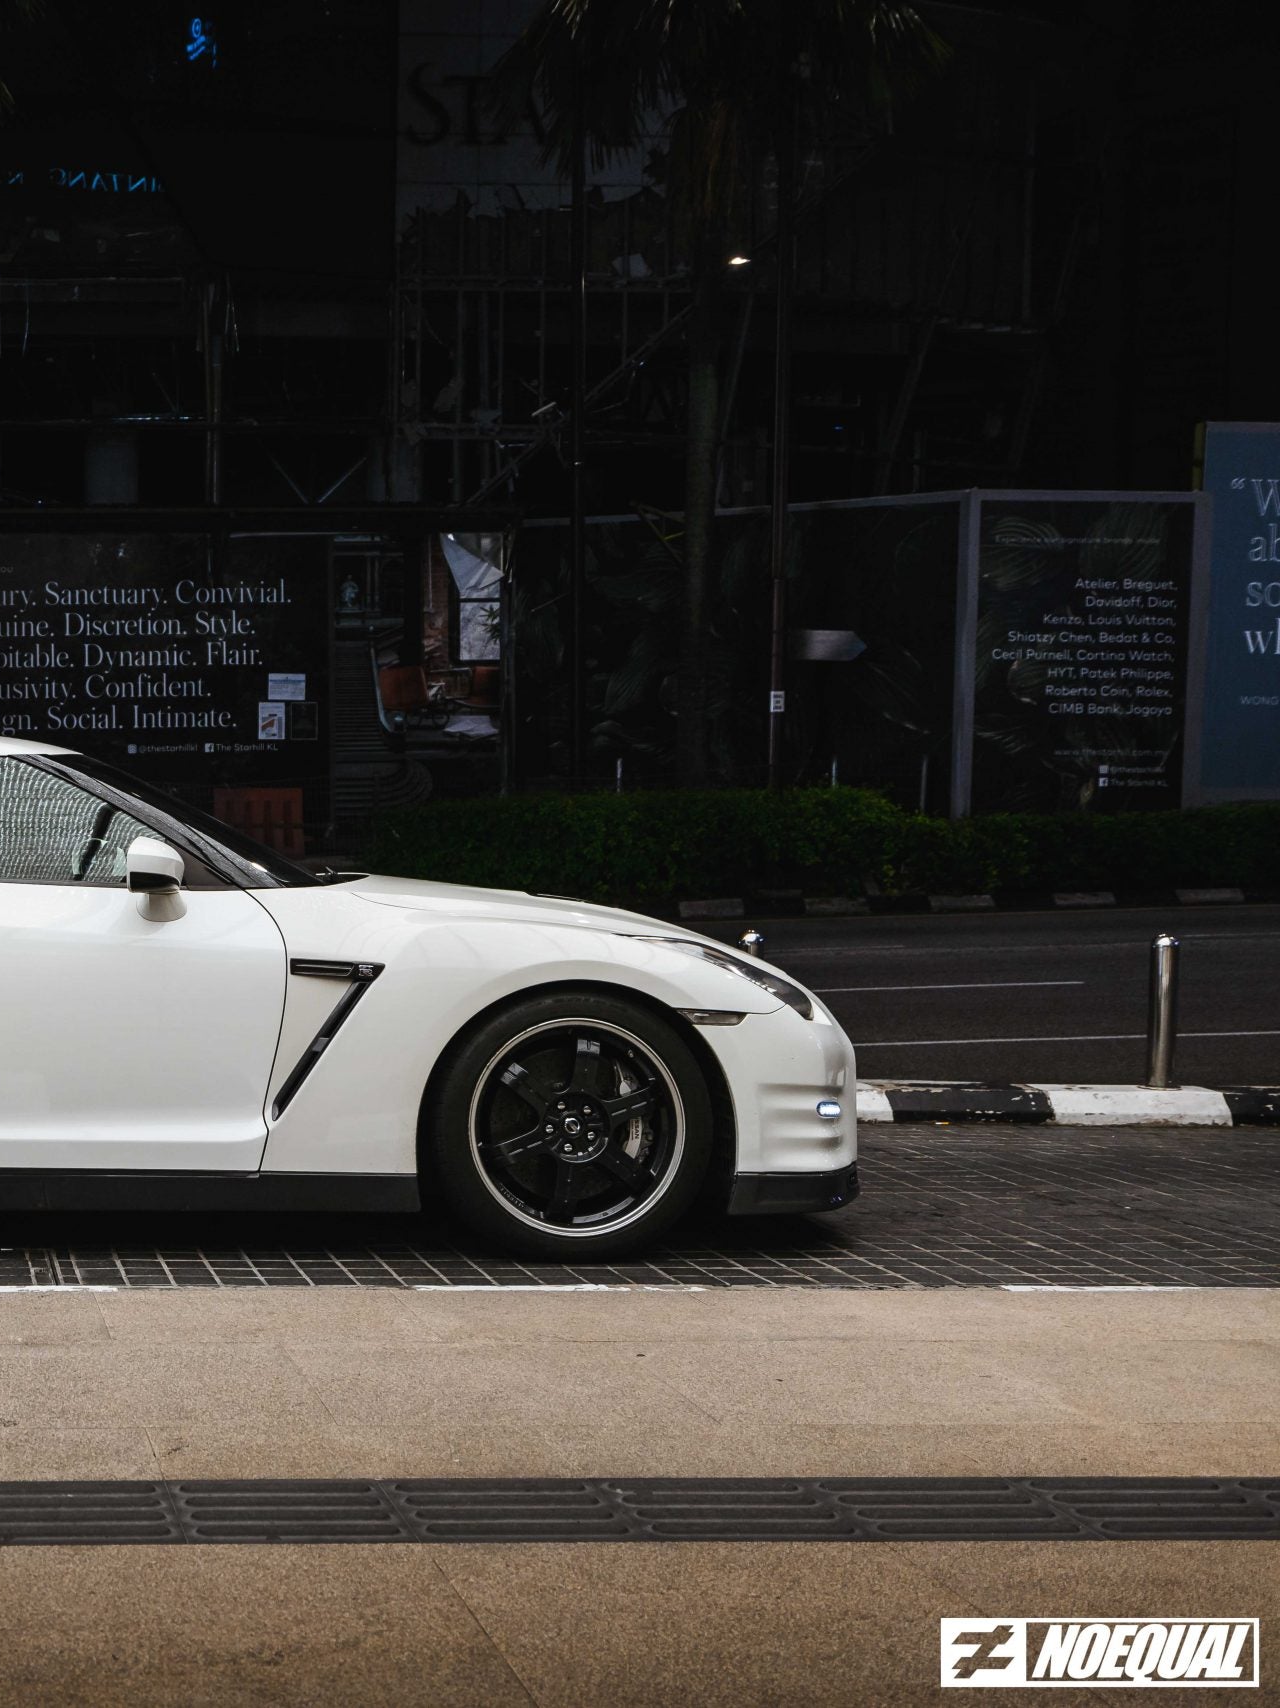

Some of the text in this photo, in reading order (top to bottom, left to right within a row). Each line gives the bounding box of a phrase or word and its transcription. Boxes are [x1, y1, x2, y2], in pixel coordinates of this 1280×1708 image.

[45, 581, 167, 611] Sanctuary.
[175, 578, 291, 605] Convivial.
[1147, 597, 1177, 609] Dior,
[65, 612, 187, 637] Discretion.
[195, 610, 256, 640] Style.
[1088, 615, 1122, 626] Louis
[1098, 632, 1138, 644] Bedat
[1141, 633, 1151, 644] &
[83, 642, 197, 674] Dynamic.
[206, 641, 263, 667] Flair.
[991, 649, 1023, 661] Cecil
[1076, 650, 1126, 662] Cortina
[1079, 668, 1118, 680] Patek
[84, 673, 212, 699] Confident.
[1044, 686, 1098, 699] Roberto
[1048, 704, 1084, 717] CIMB
[47, 704, 123, 731] Social.
[133, 704, 238, 730] Intimate.
[214, 744, 231, 752] The
